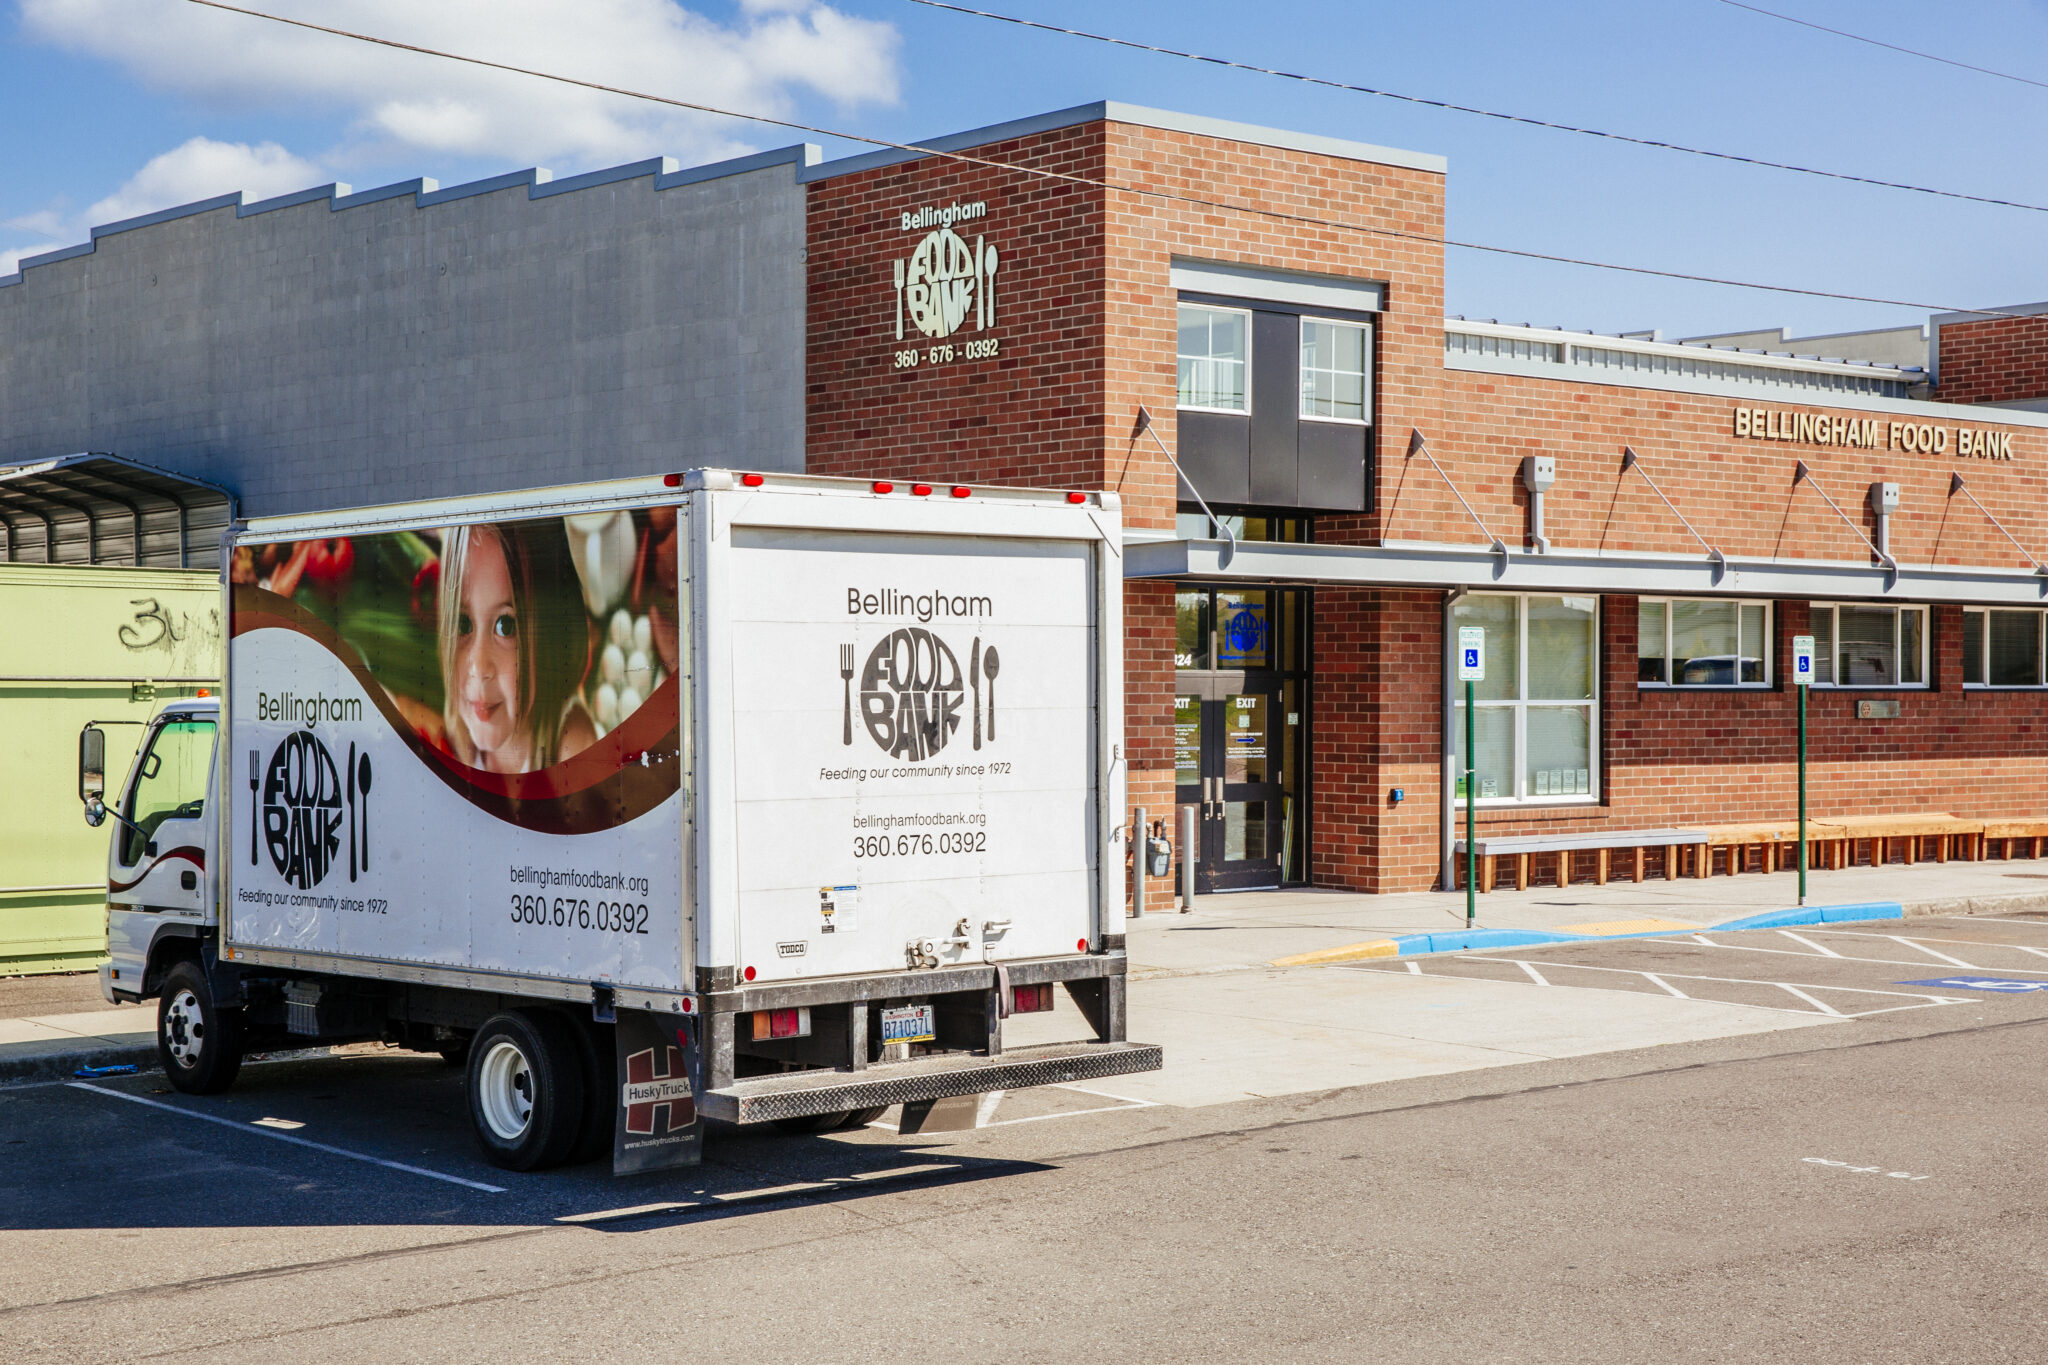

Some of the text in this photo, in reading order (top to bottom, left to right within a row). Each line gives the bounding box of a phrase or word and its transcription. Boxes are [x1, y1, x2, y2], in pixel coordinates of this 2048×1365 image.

[901, 201, 986, 231] Bellingham
[907, 229, 975, 285] FOOD
[907, 278, 975, 338] BANK
[1734, 407, 2015, 460] BELLINGHAM FOOD BANK
[848, 587, 992, 622] Bellingham
[860, 627, 964, 694] FOOD
[258, 692, 363, 729] Bellingham
[1175, 698, 1190, 709] XIT
[1236, 698, 1256, 708] EXIT
[860, 691, 964, 762] BANK
[263, 731, 343, 811] FOOD
[819, 762, 1011, 782] Feeding our community since 1972
[853, 812, 986, 830] bellinghamfoodbank.org
[263, 806, 343, 890] BANK
[853, 832, 987, 858] 360.676.0392
[510, 865, 649, 897] bellinghamfoodbank.org
[238, 888, 388, 915] Feeding our community since 1972
[510, 894, 649, 934] 360.676.0392
[779, 943, 804, 954] TODCO
[884, 1017, 932, 1039] B71037L
[624, 1135, 696, 1150] www.huskytrucks.com
